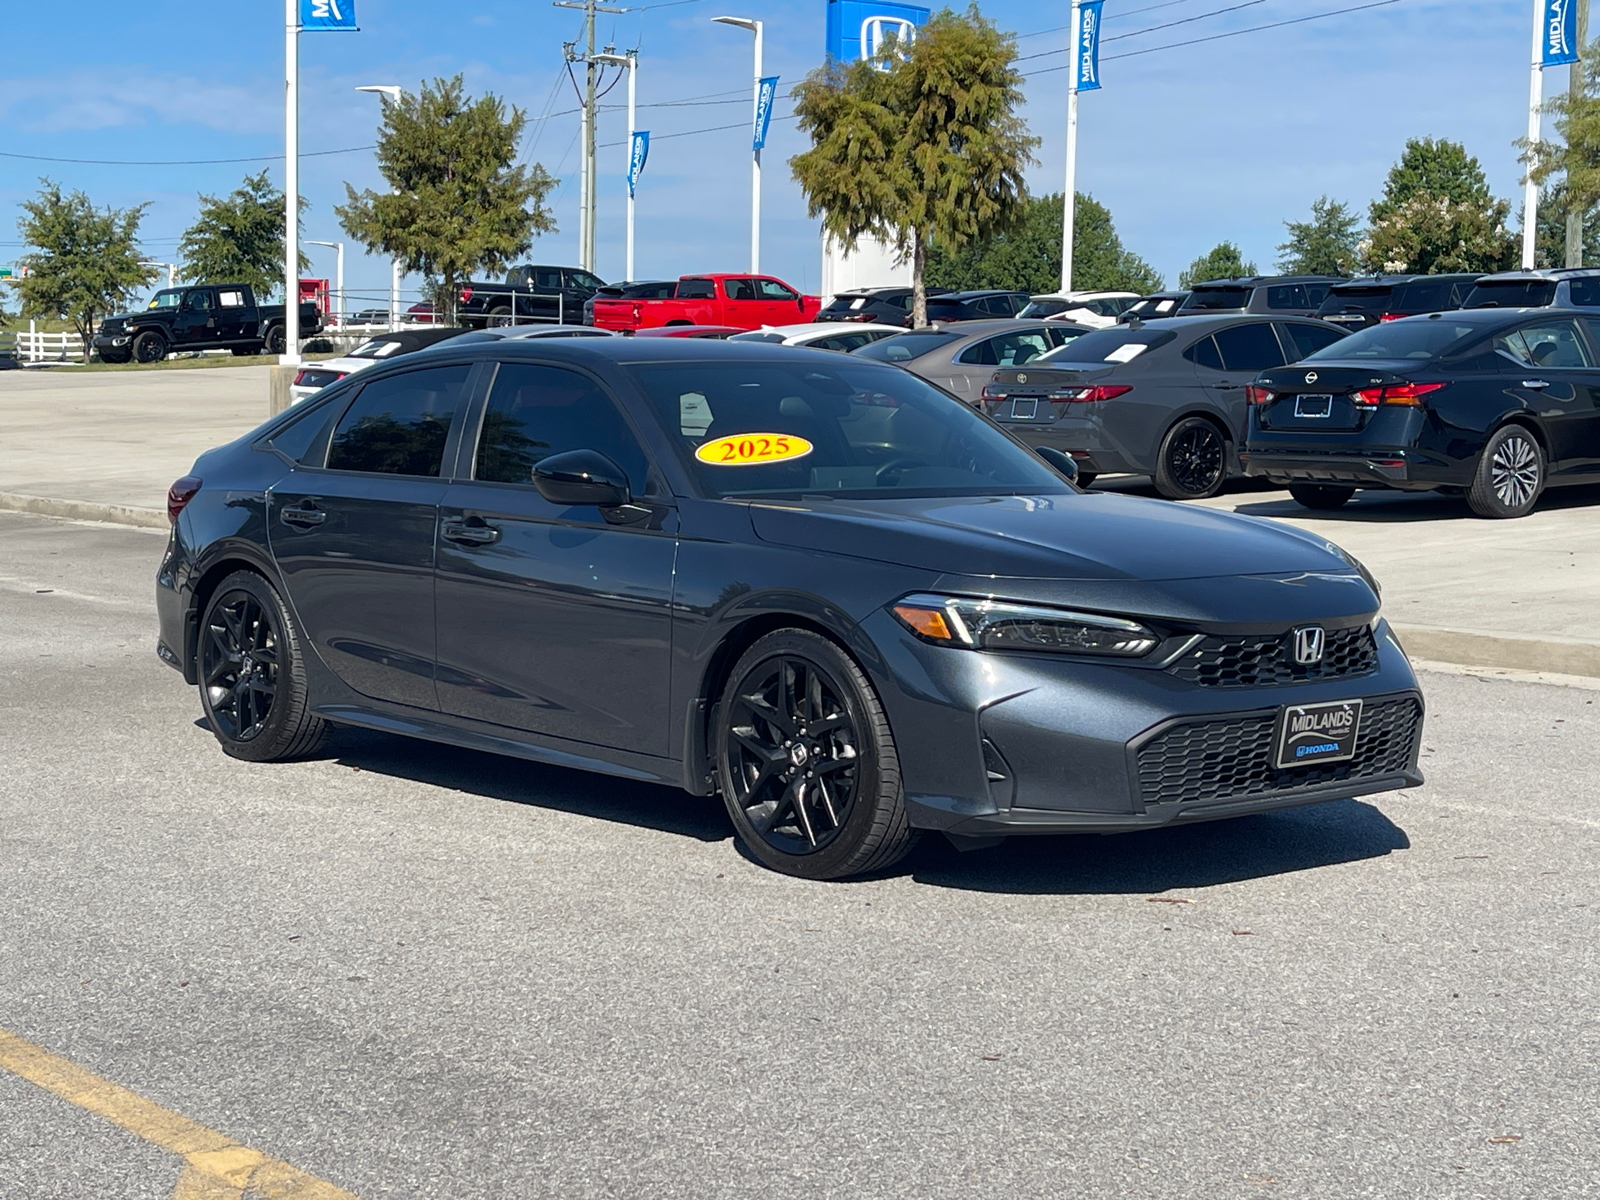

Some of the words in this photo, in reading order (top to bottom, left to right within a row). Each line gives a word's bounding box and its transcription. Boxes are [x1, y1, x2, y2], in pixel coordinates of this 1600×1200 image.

[1081, 8, 1092, 82] MIDLANDS
[754, 83, 770, 142] MIDLANDS
[720, 438, 790, 461] 2025
[1291, 709, 1354, 733] MIDLANDS
[1305, 742, 1339, 754] HONDA
